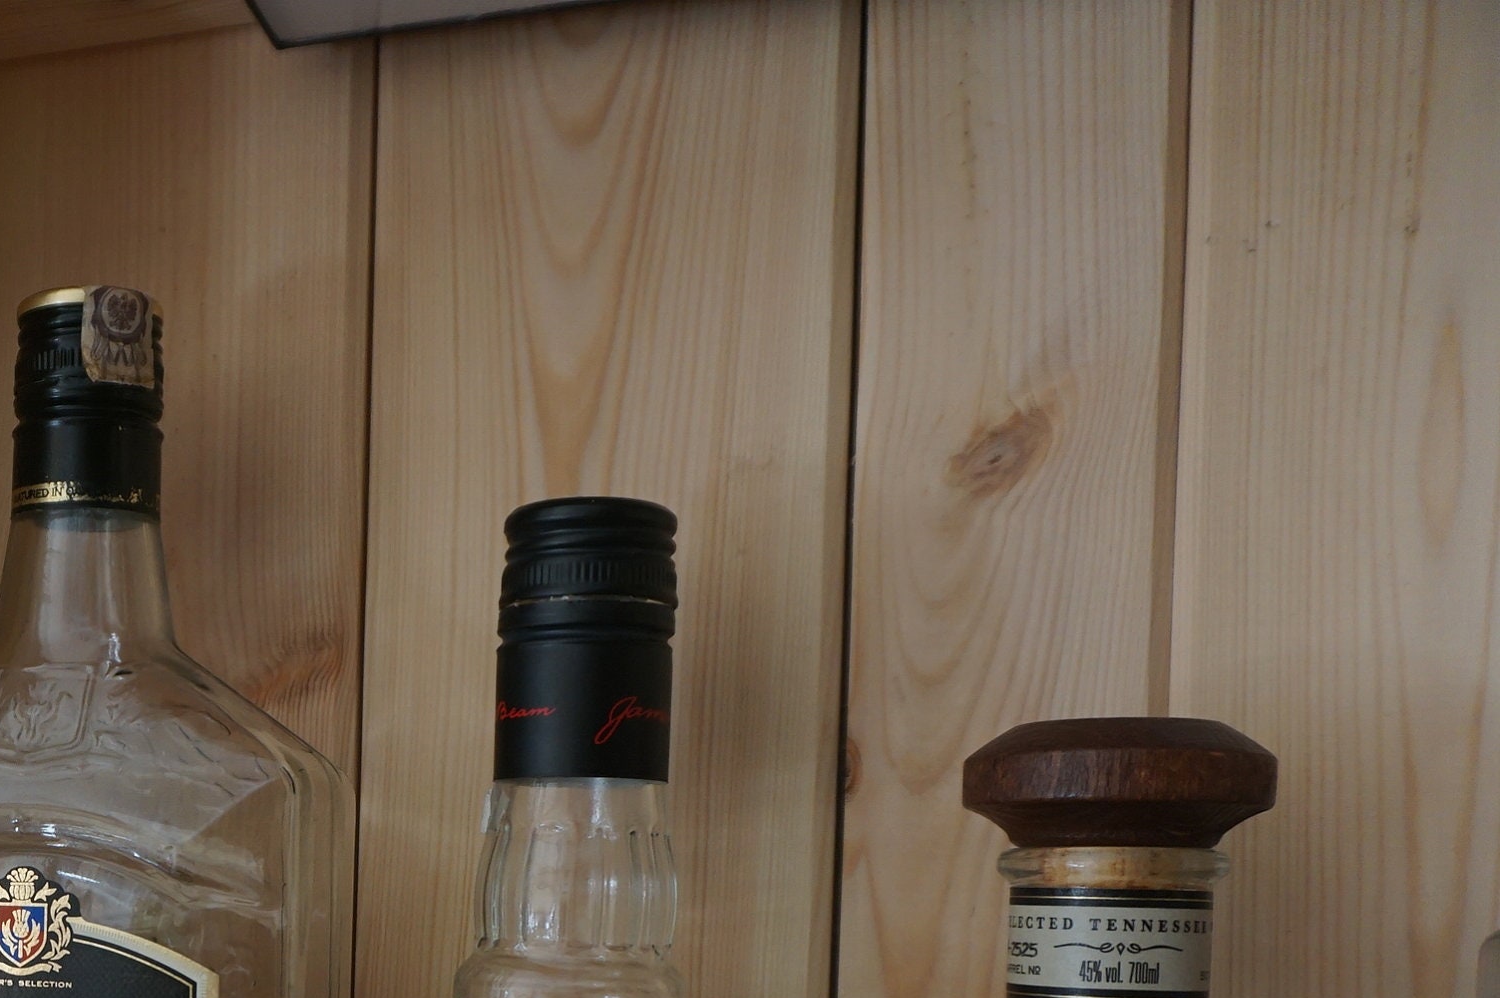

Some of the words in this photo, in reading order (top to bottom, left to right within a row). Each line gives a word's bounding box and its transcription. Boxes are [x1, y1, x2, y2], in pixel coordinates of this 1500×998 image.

[1079, 960, 1102, 984] 45%
[1105, 962, 1123, 984] vol.
[1129, 962, 1160, 985] 700ml
[18, 980, 72, 989] SELECTION
